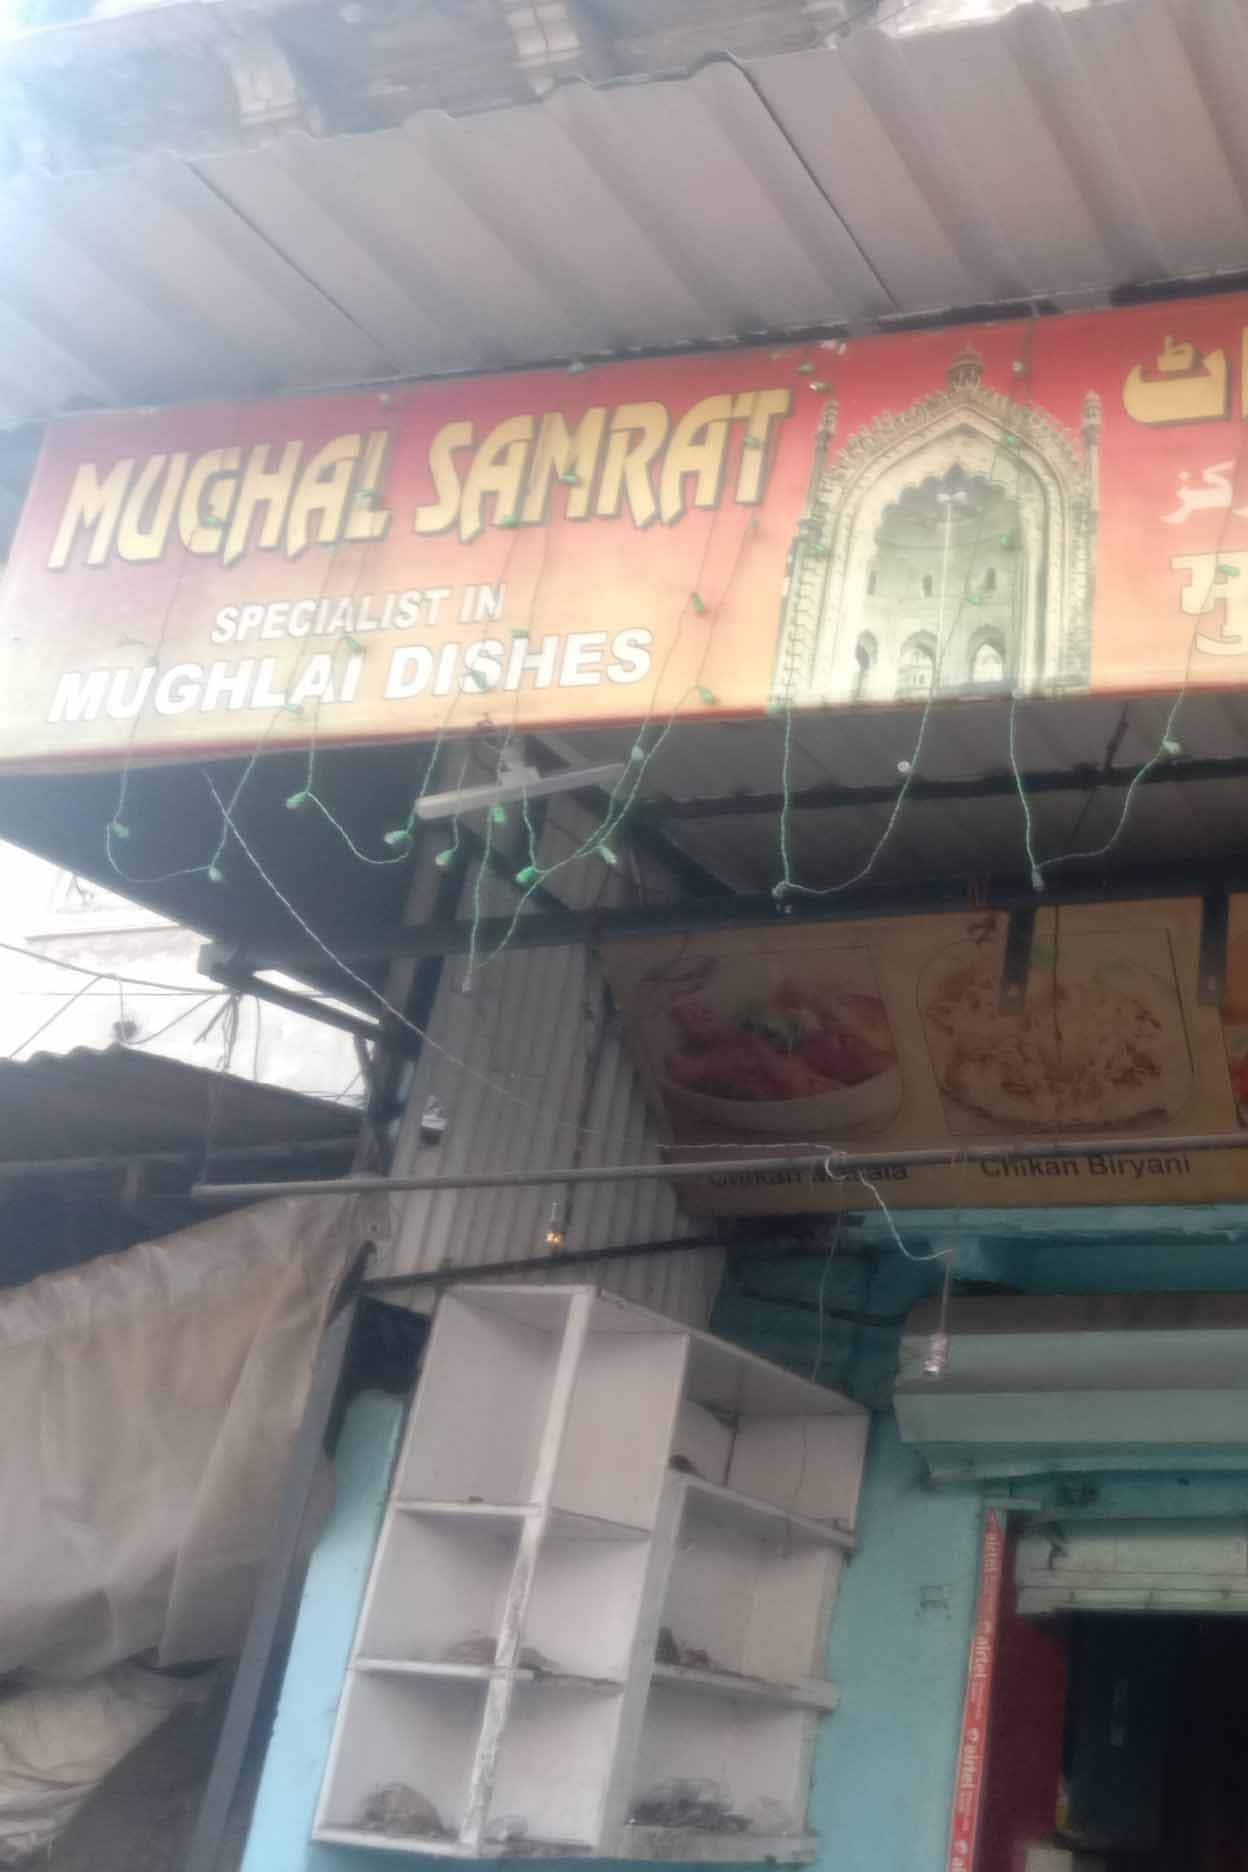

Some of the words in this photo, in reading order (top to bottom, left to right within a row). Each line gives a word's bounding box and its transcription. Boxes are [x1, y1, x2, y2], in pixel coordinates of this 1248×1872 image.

[48, 431, 392, 570] MUGHAL
[414, 389, 791, 543] SAMRAT
[210, 585, 450, 646] SPECIALIST
[458, 582, 507, 626] IN
[47, 648, 363, 724] MUGHLAI
[384, 627, 656, 702] DISHES
[978, 1155, 1080, 1180] Chikan
[1085, 1152, 1192, 1181] Biryani
[961, 1744, 982, 1791] airtel
